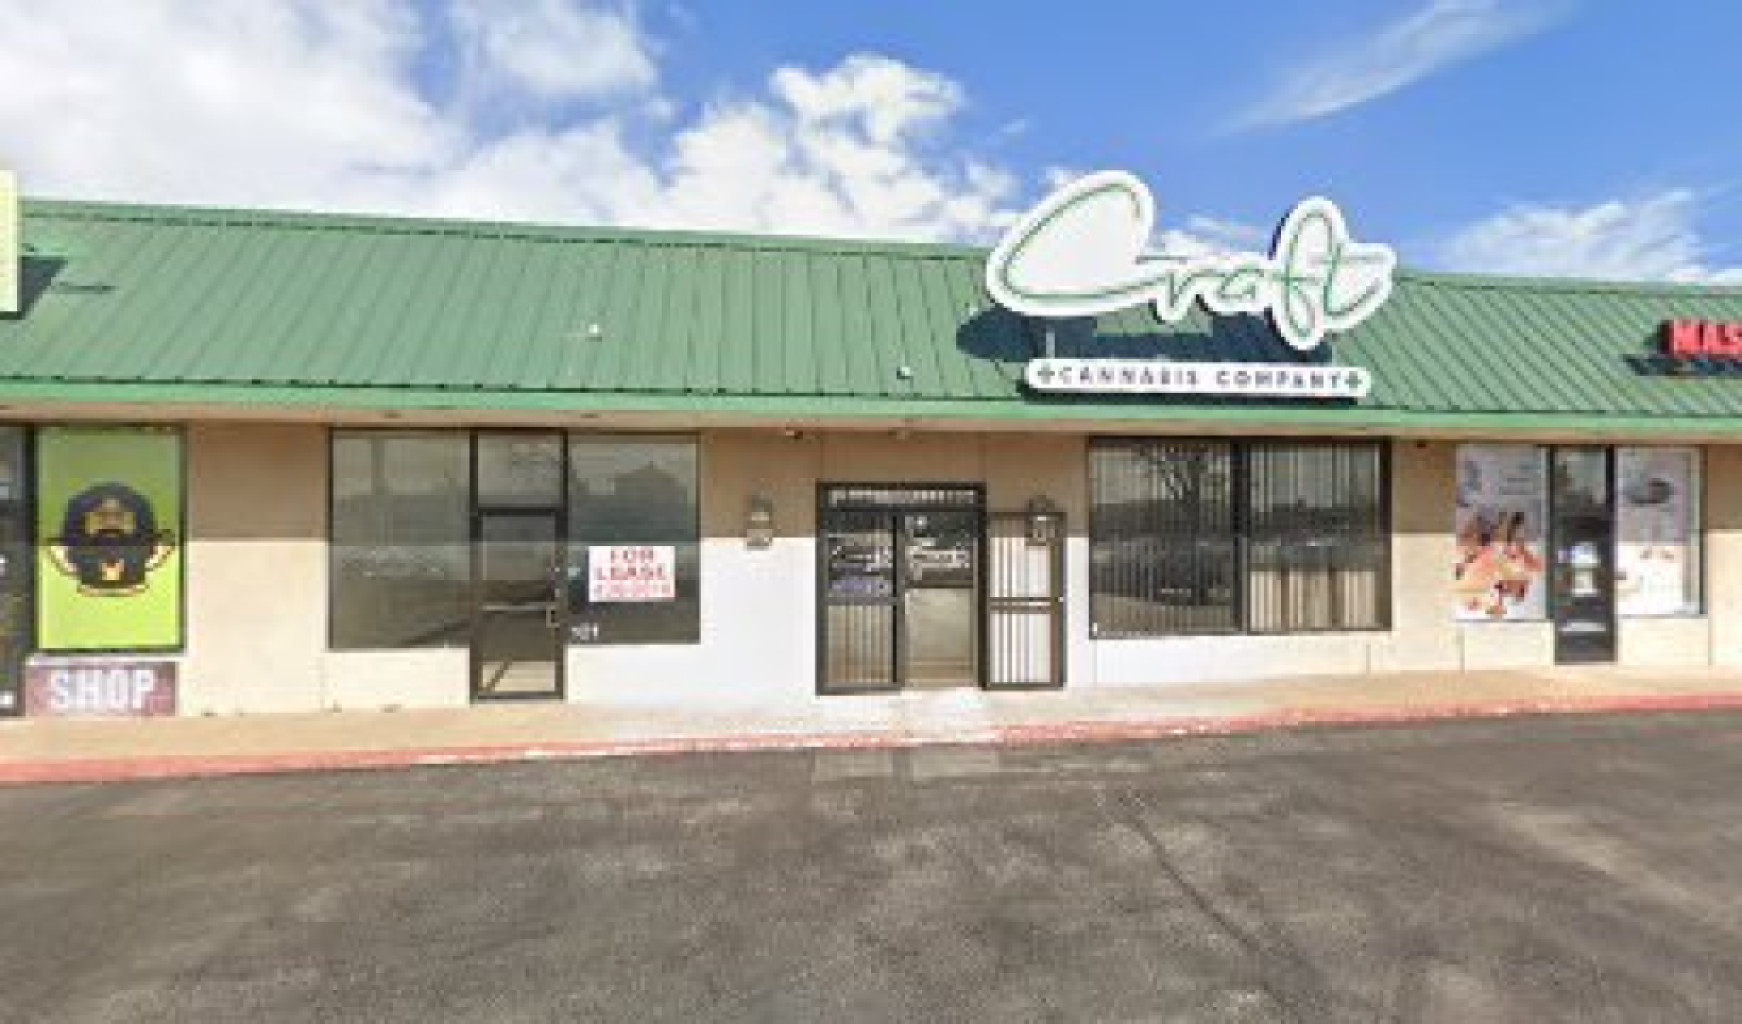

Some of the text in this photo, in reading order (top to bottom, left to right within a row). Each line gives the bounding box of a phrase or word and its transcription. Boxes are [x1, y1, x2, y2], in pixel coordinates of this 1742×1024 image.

[1001, 183, 1384, 338] Craft
[1059, 366, 1340, 389] CANNABIS COMPANY
[610, 548, 654, 563] FOR
[595, 566, 667, 581] LEASE
[50, 668, 155, 709] SHOP
